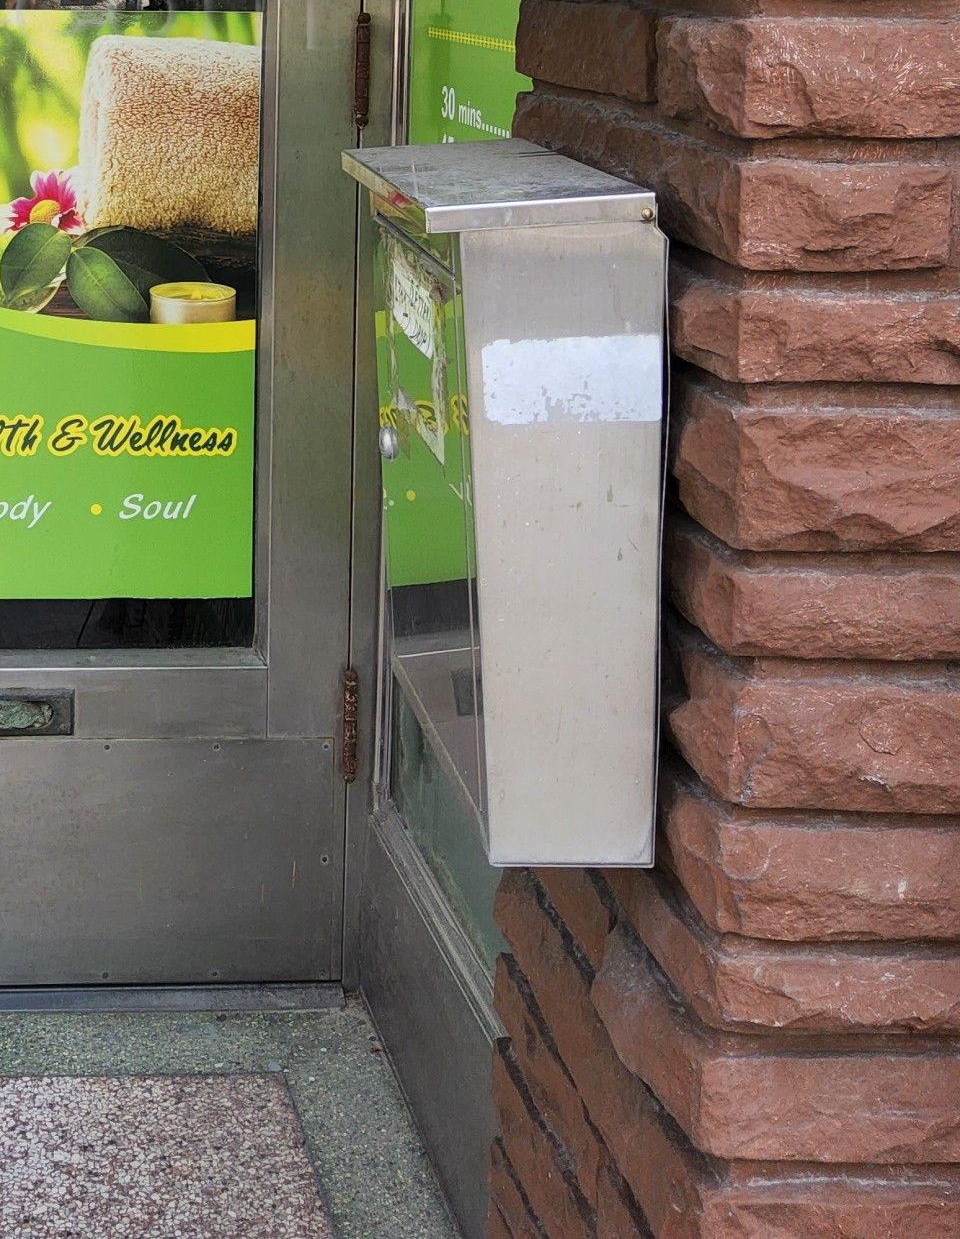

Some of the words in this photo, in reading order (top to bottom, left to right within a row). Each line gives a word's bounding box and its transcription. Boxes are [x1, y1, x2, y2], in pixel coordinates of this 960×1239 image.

[441, 85, 456, 121] 30
[50, 417, 86, 453] &
[93, 416, 236, 455] Wellness
[119, 493, 197, 521] Soul
